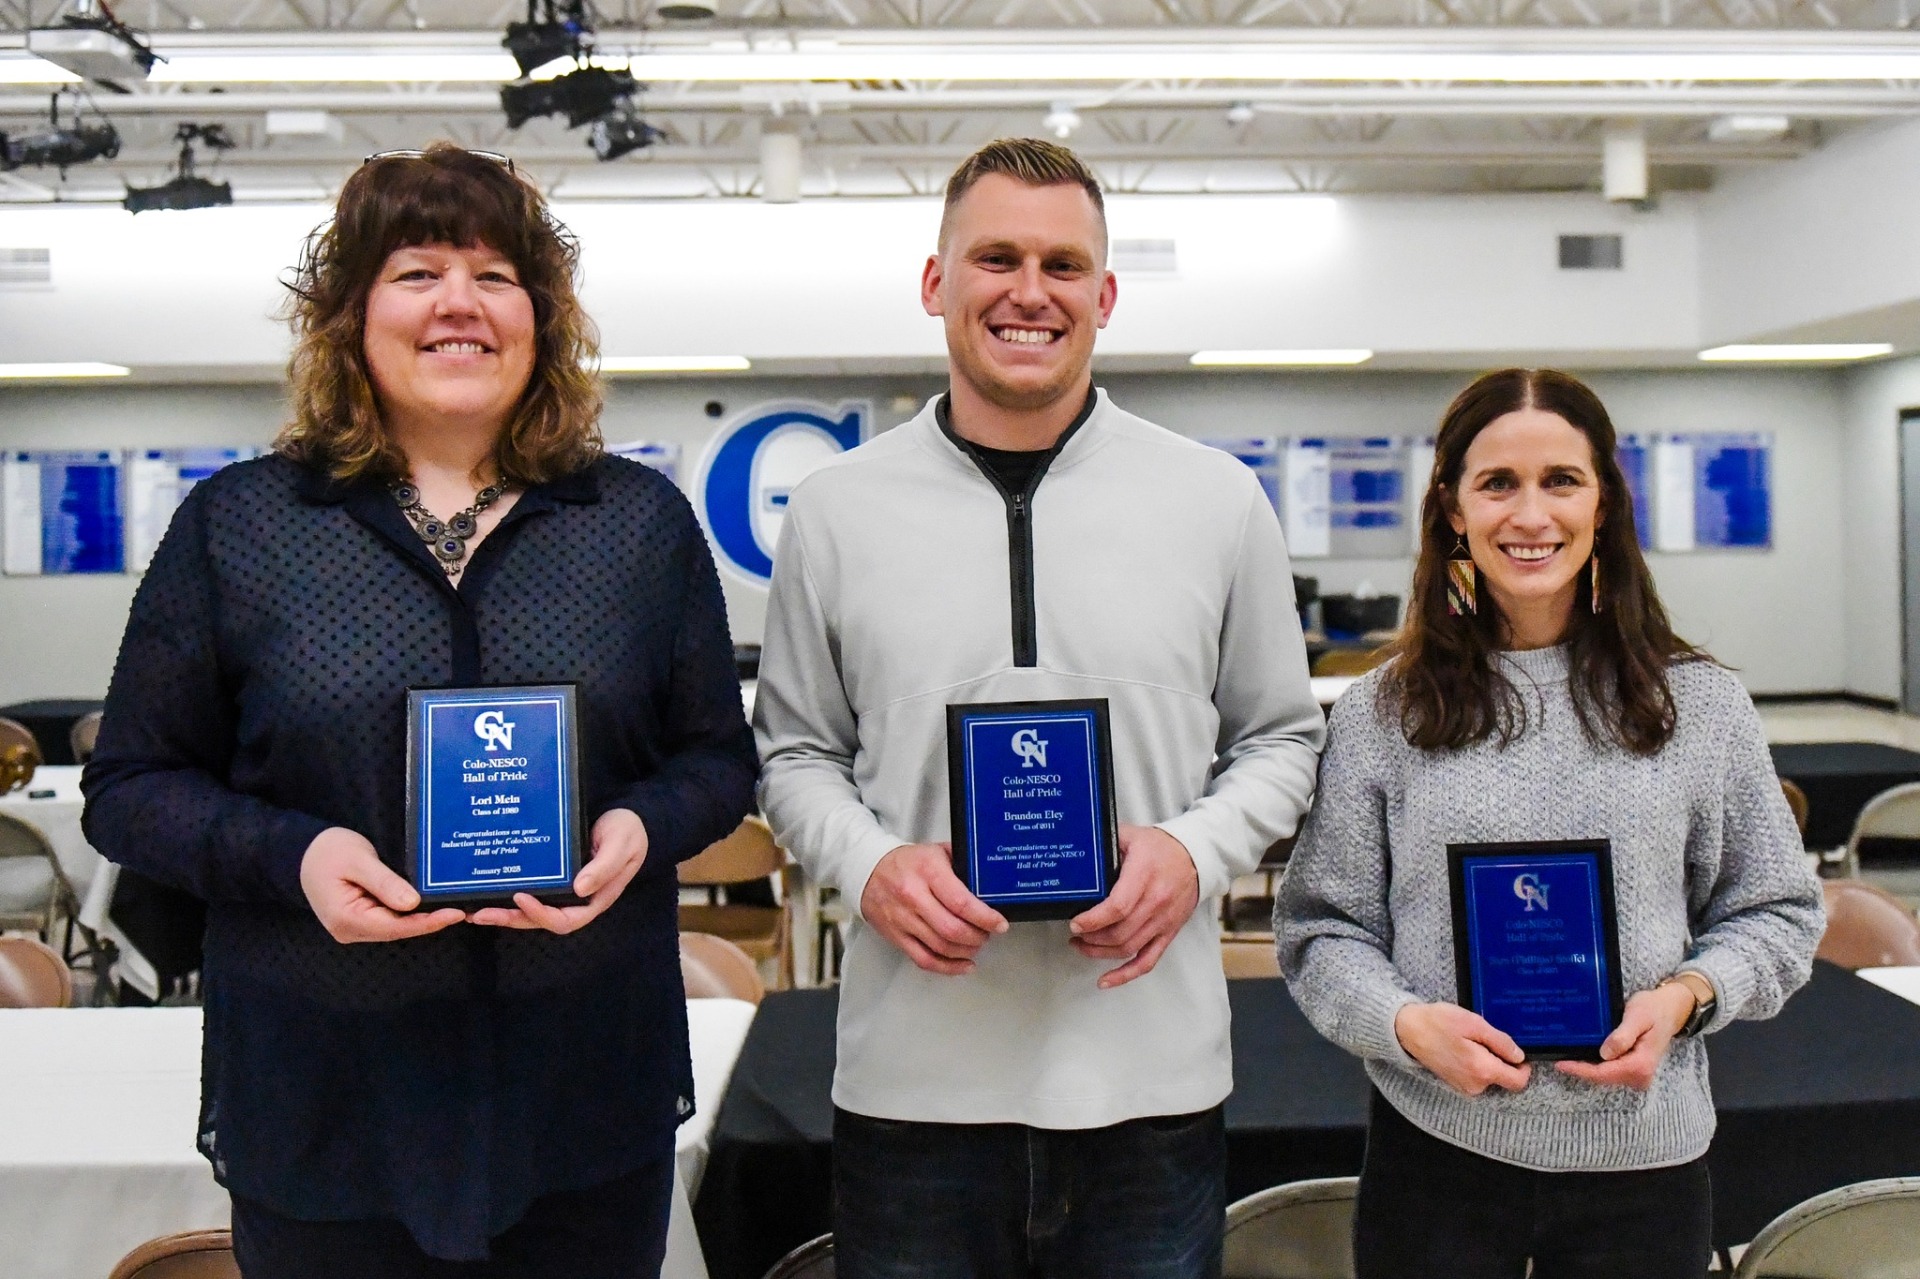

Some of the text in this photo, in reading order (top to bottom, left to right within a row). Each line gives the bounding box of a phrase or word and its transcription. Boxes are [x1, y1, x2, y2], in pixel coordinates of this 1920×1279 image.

[474, 711, 516, 751] CN
[1011, 729, 1048, 767] CN
[463, 757, 527, 769] Colo-NESCO
[463, 771, 528, 782] Hall of Pride
[1003, 774, 1061, 785] Colo-NESCO
[1004, 788, 1062, 798] Hall of Pride
[471, 795, 520, 805] Lori Mein
[472, 808, 491, 816] Class
[1004, 810, 1064, 820] Brandon Eley
[453, 829, 510, 839] Congratulations
[441, 840, 475, 848] induction
[505, 836, 550, 844] Colo-NESCO
[474, 848, 490, 856] Hall
[997, 844, 1048, 852] Congratulations
[1514, 873, 1550, 912] CN
